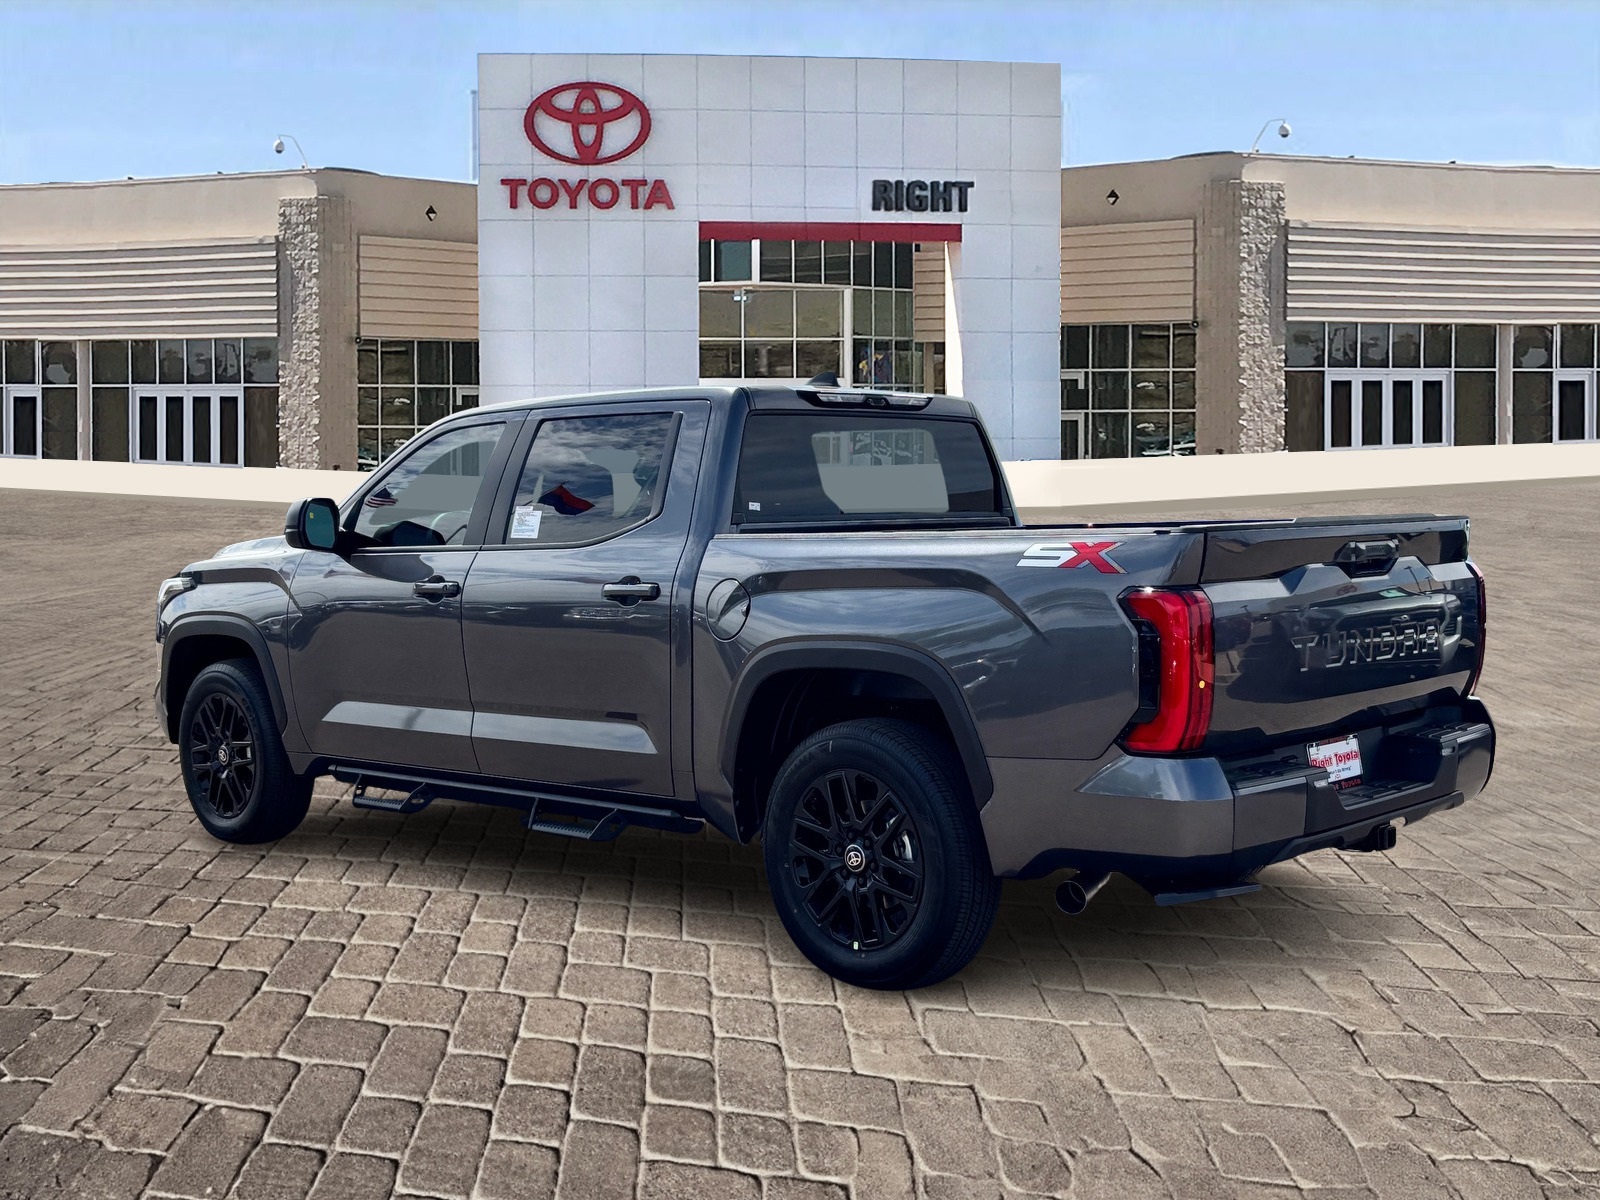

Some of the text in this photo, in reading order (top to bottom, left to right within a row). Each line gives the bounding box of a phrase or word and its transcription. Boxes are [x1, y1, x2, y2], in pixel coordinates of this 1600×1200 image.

[500, 177, 675, 210] TOYOTA
[872, 179, 975, 213] RIGHT
[1016, 541, 1129, 574] SX
[1290, 617, 1441, 672] TUNDRA
[1334, 750, 1359, 765] Toyota
